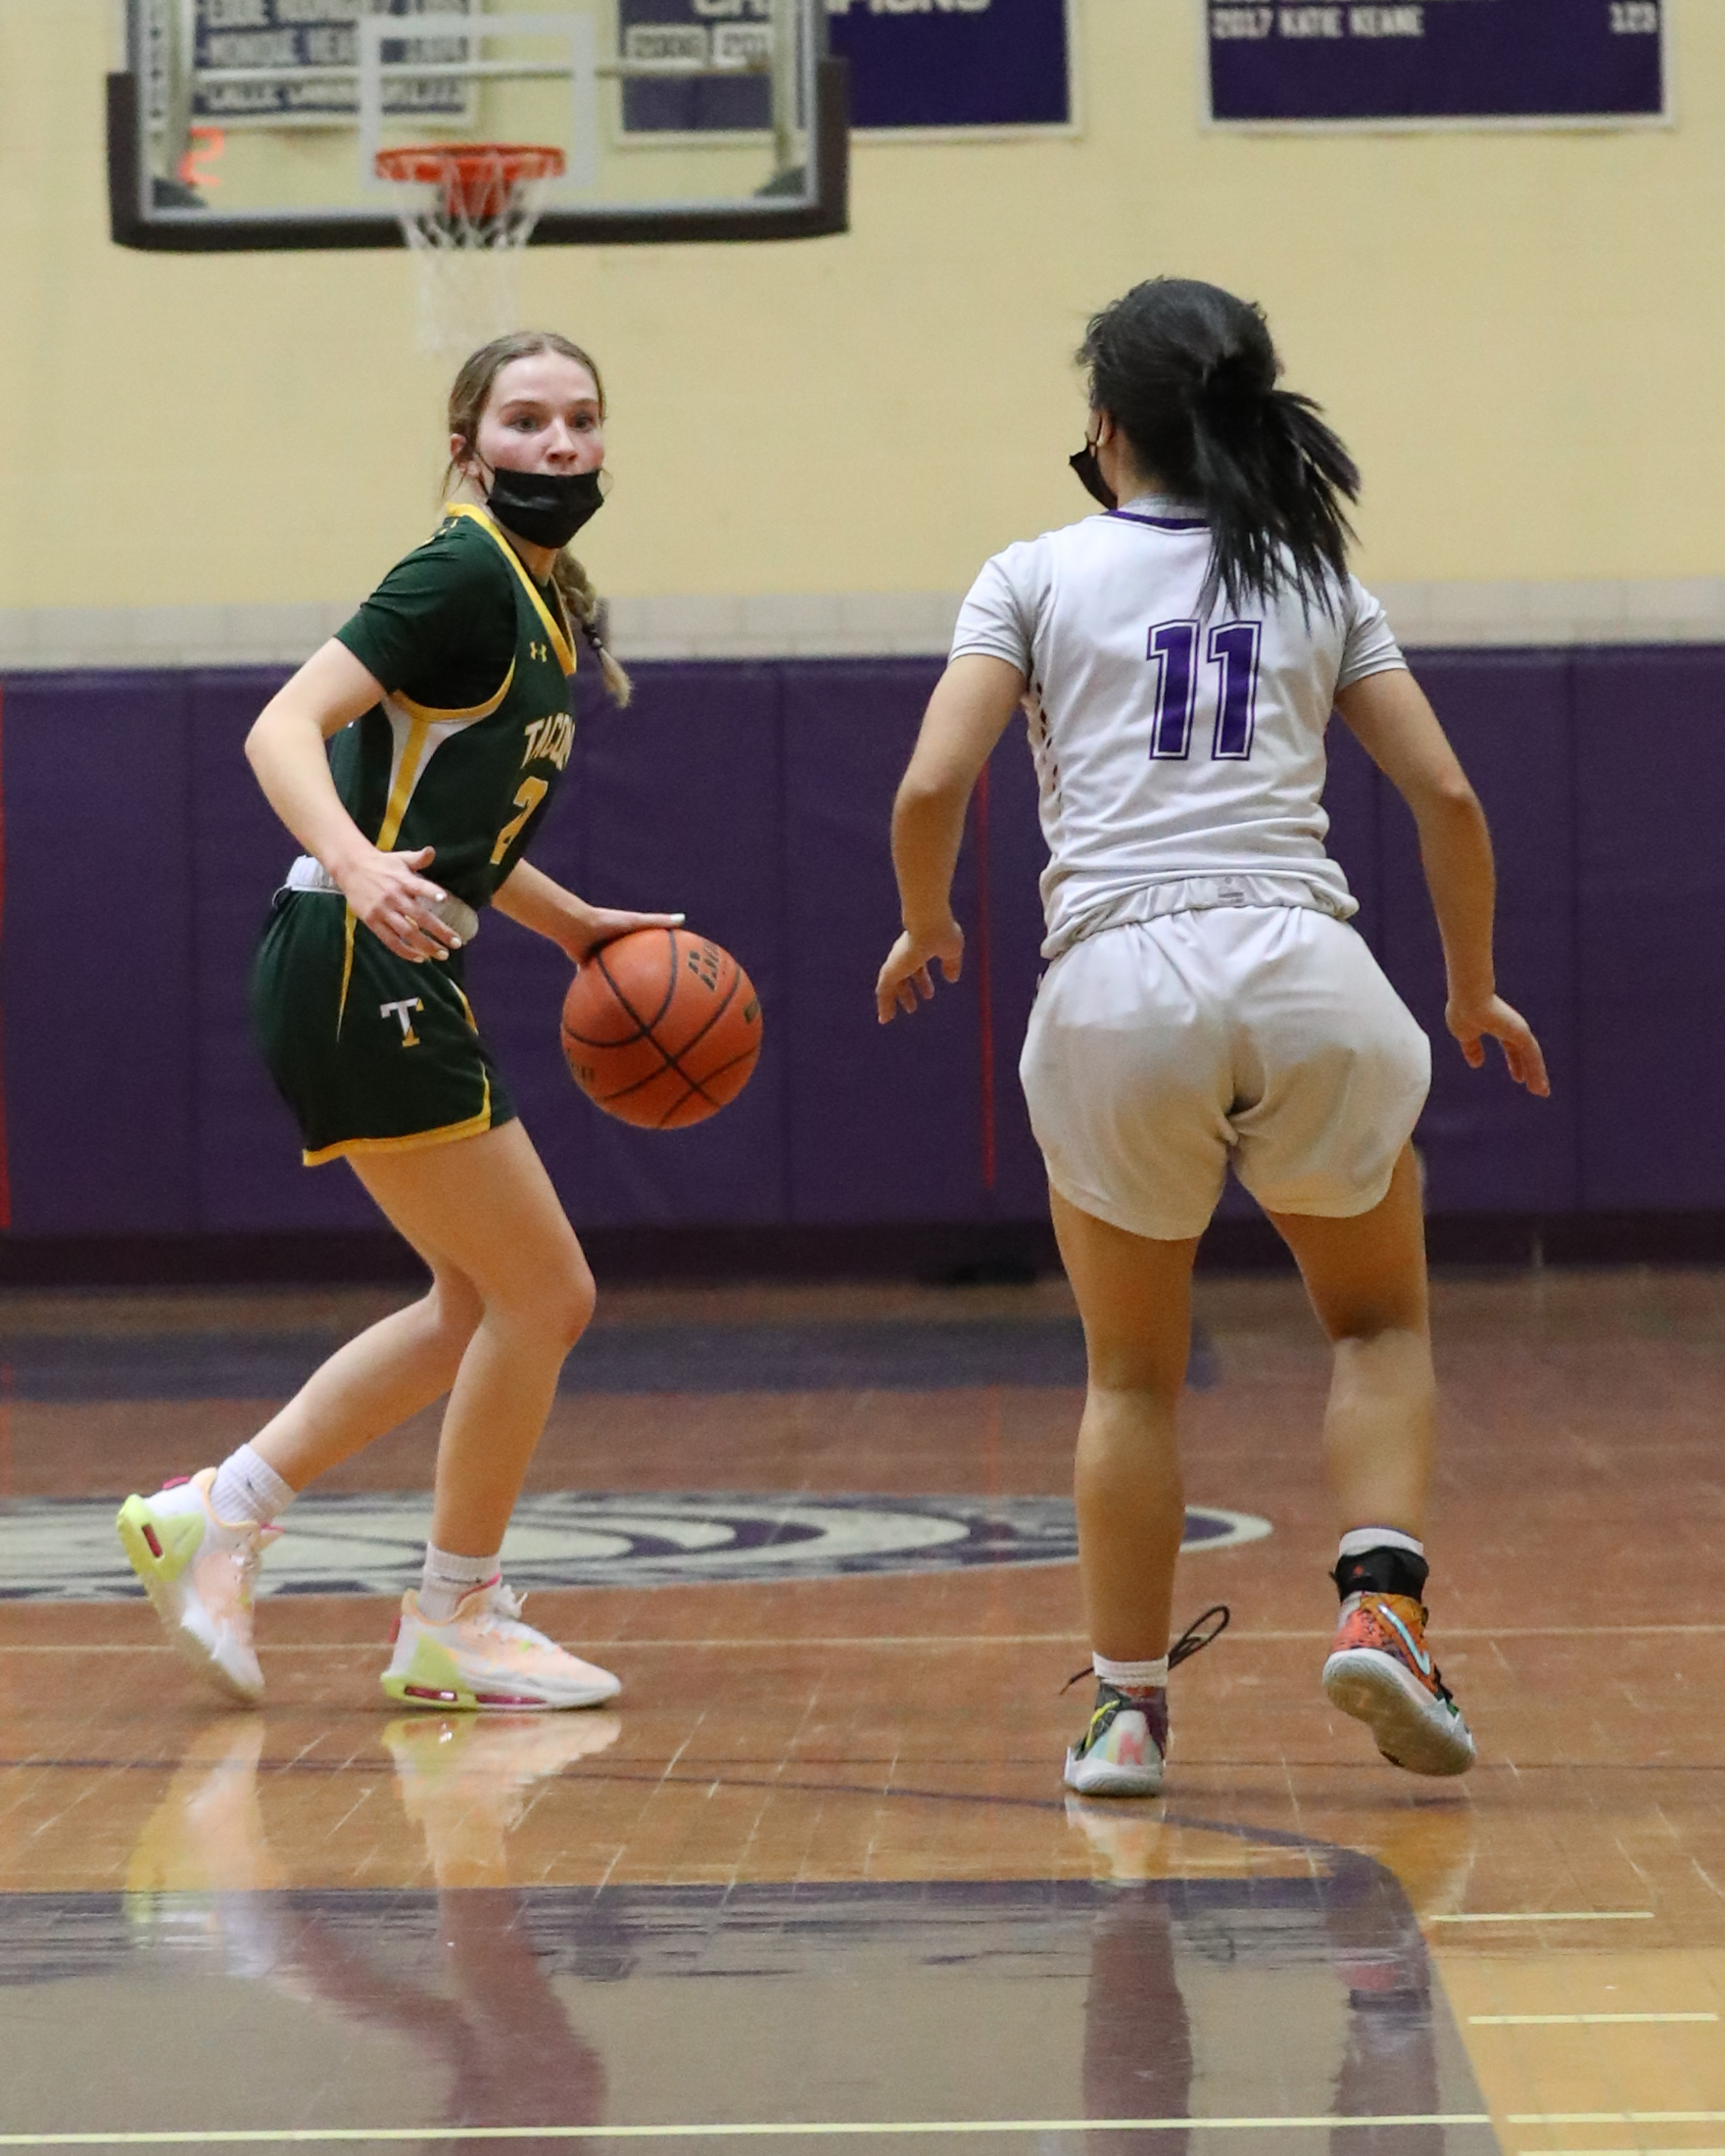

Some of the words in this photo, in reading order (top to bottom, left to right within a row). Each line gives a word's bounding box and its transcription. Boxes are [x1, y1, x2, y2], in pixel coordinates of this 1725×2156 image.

[1146, 619, 1262, 761] 11
[490, 776, 550, 865] 2
[380, 997, 424, 1047] T
